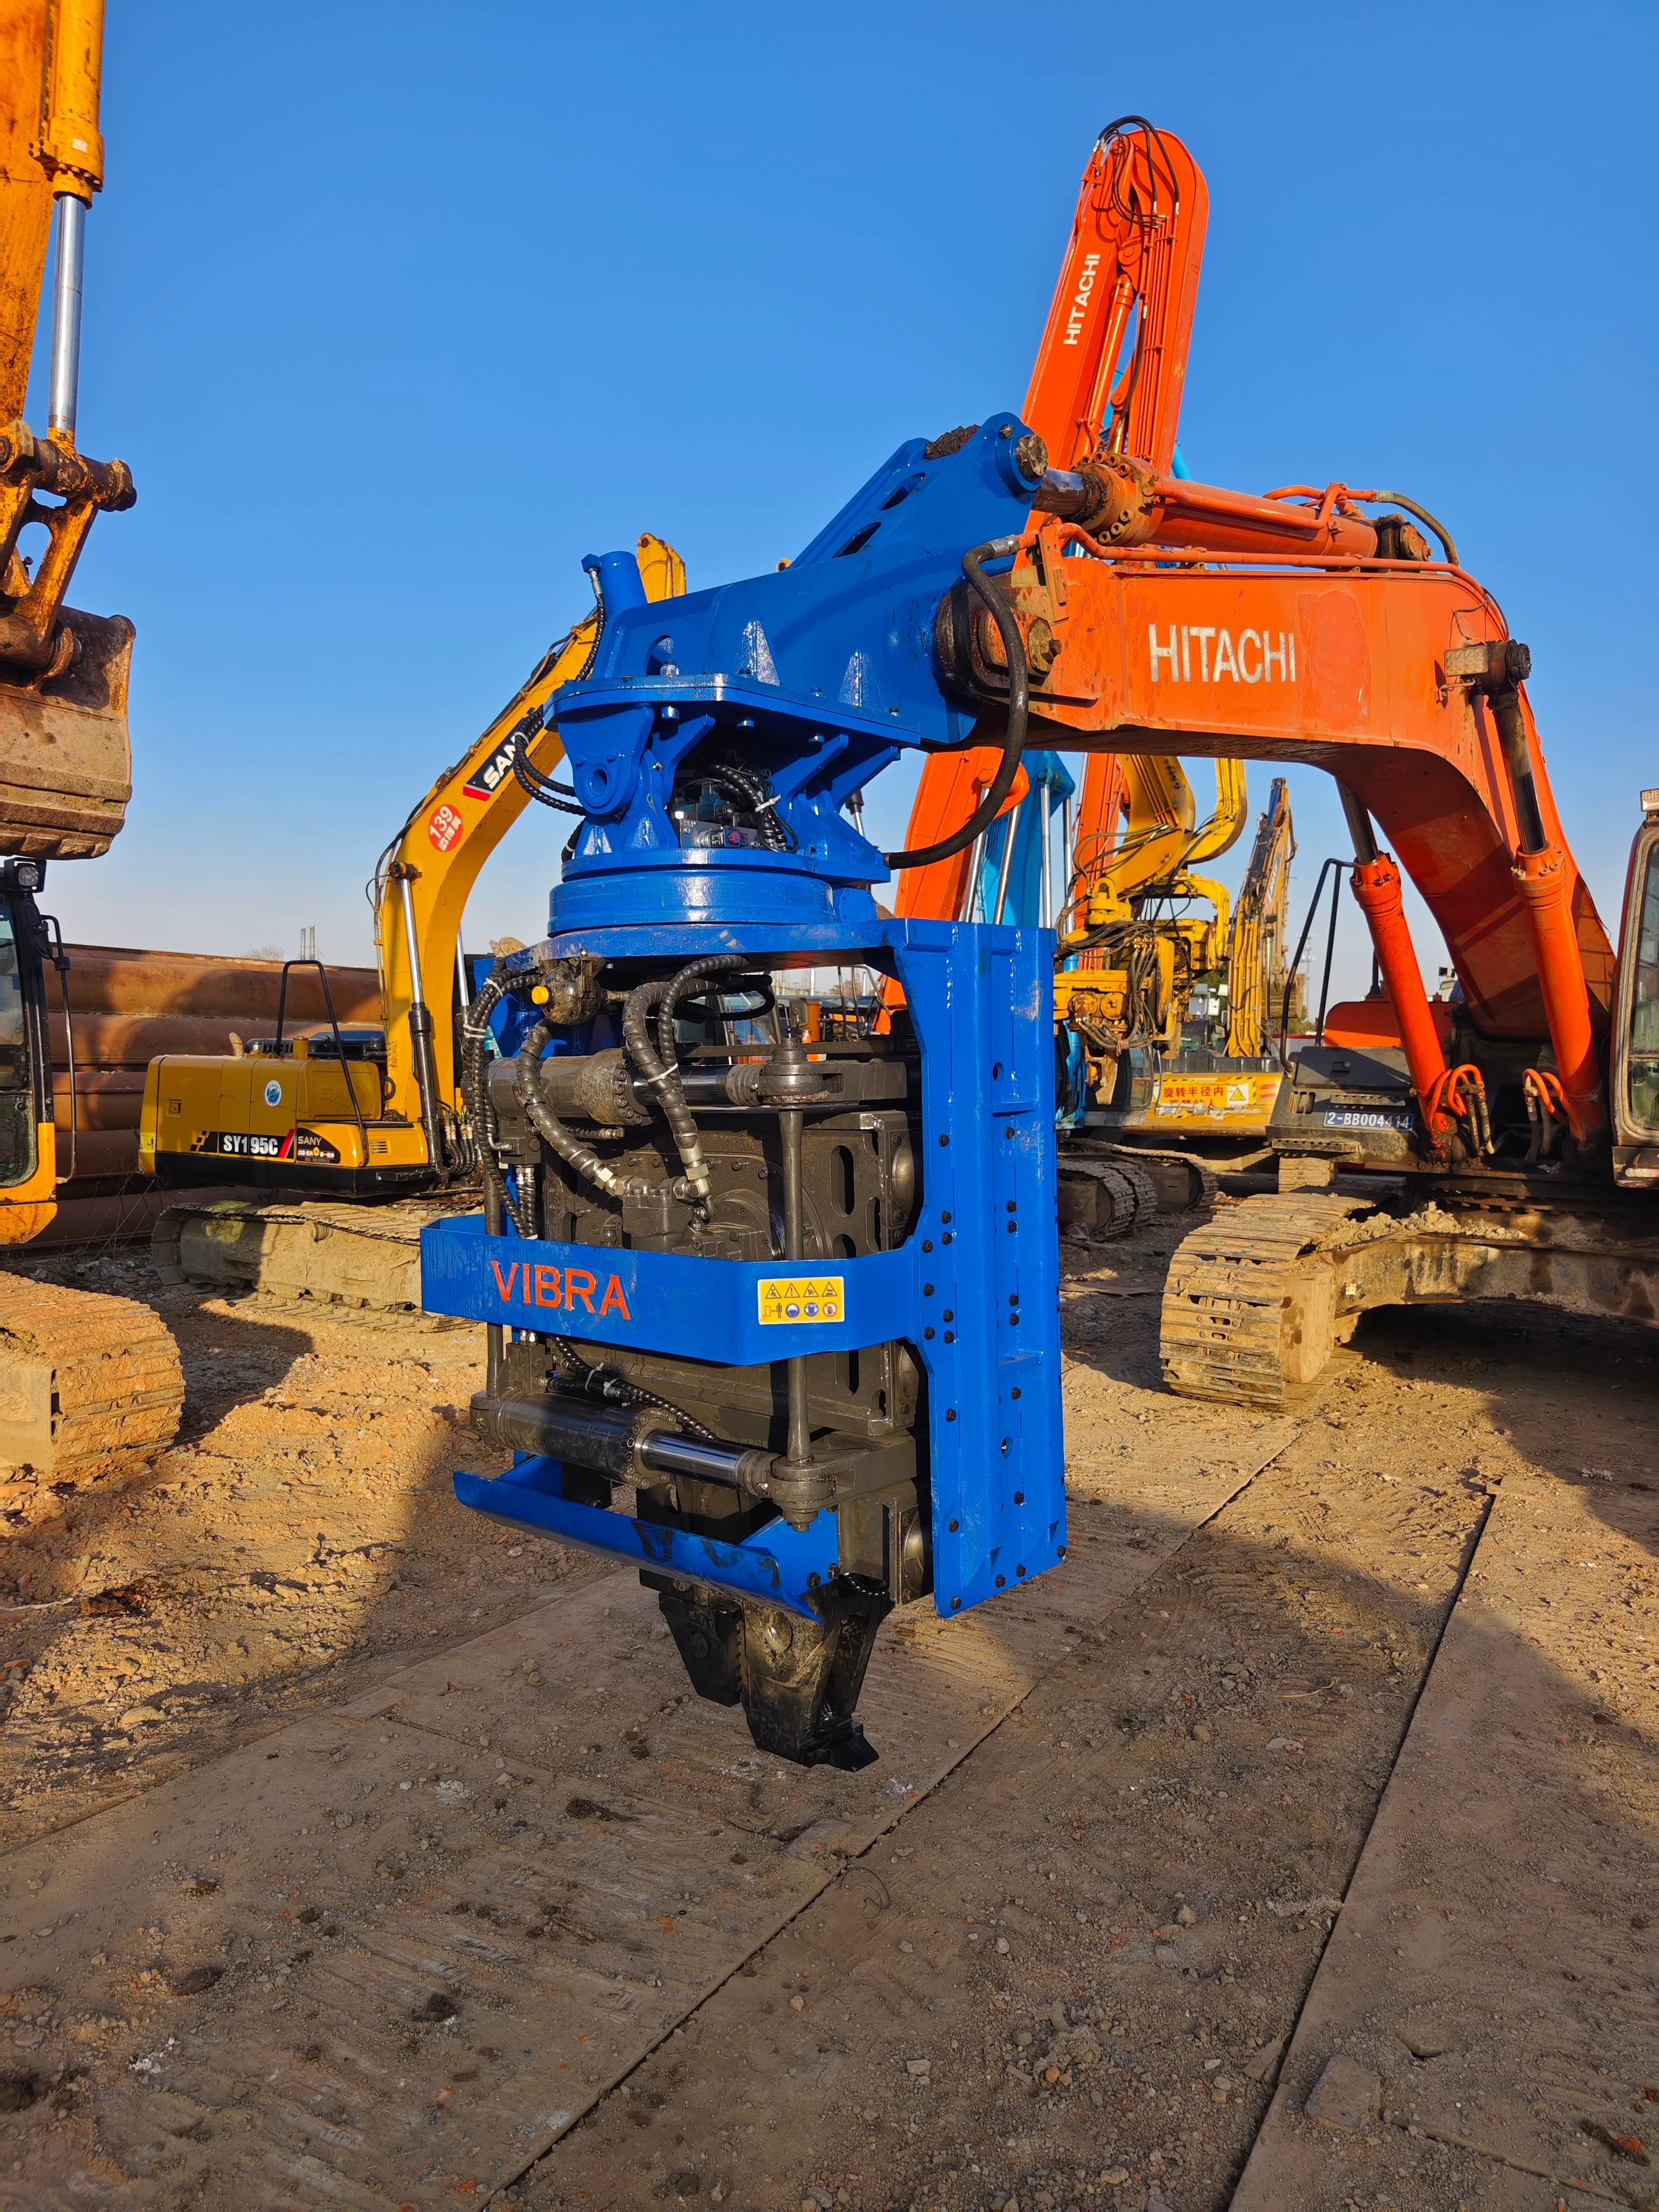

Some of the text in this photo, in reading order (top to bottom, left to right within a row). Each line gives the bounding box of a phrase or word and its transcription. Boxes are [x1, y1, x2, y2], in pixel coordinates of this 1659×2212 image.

[1063, 254, 1101, 345] HITACHI
[1148, 624, 1296, 684] HITACHI
[430, 806, 453, 839] 139
[1163, 1085, 1224, 1098] 旋转半径内
[1327, 1111, 1410, 1129] 2-BB004414
[223, 1135, 278, 1155] SY195C
[298, 1136, 322, 1146] SANY
[490, 1260, 632, 1321] VIBRA
